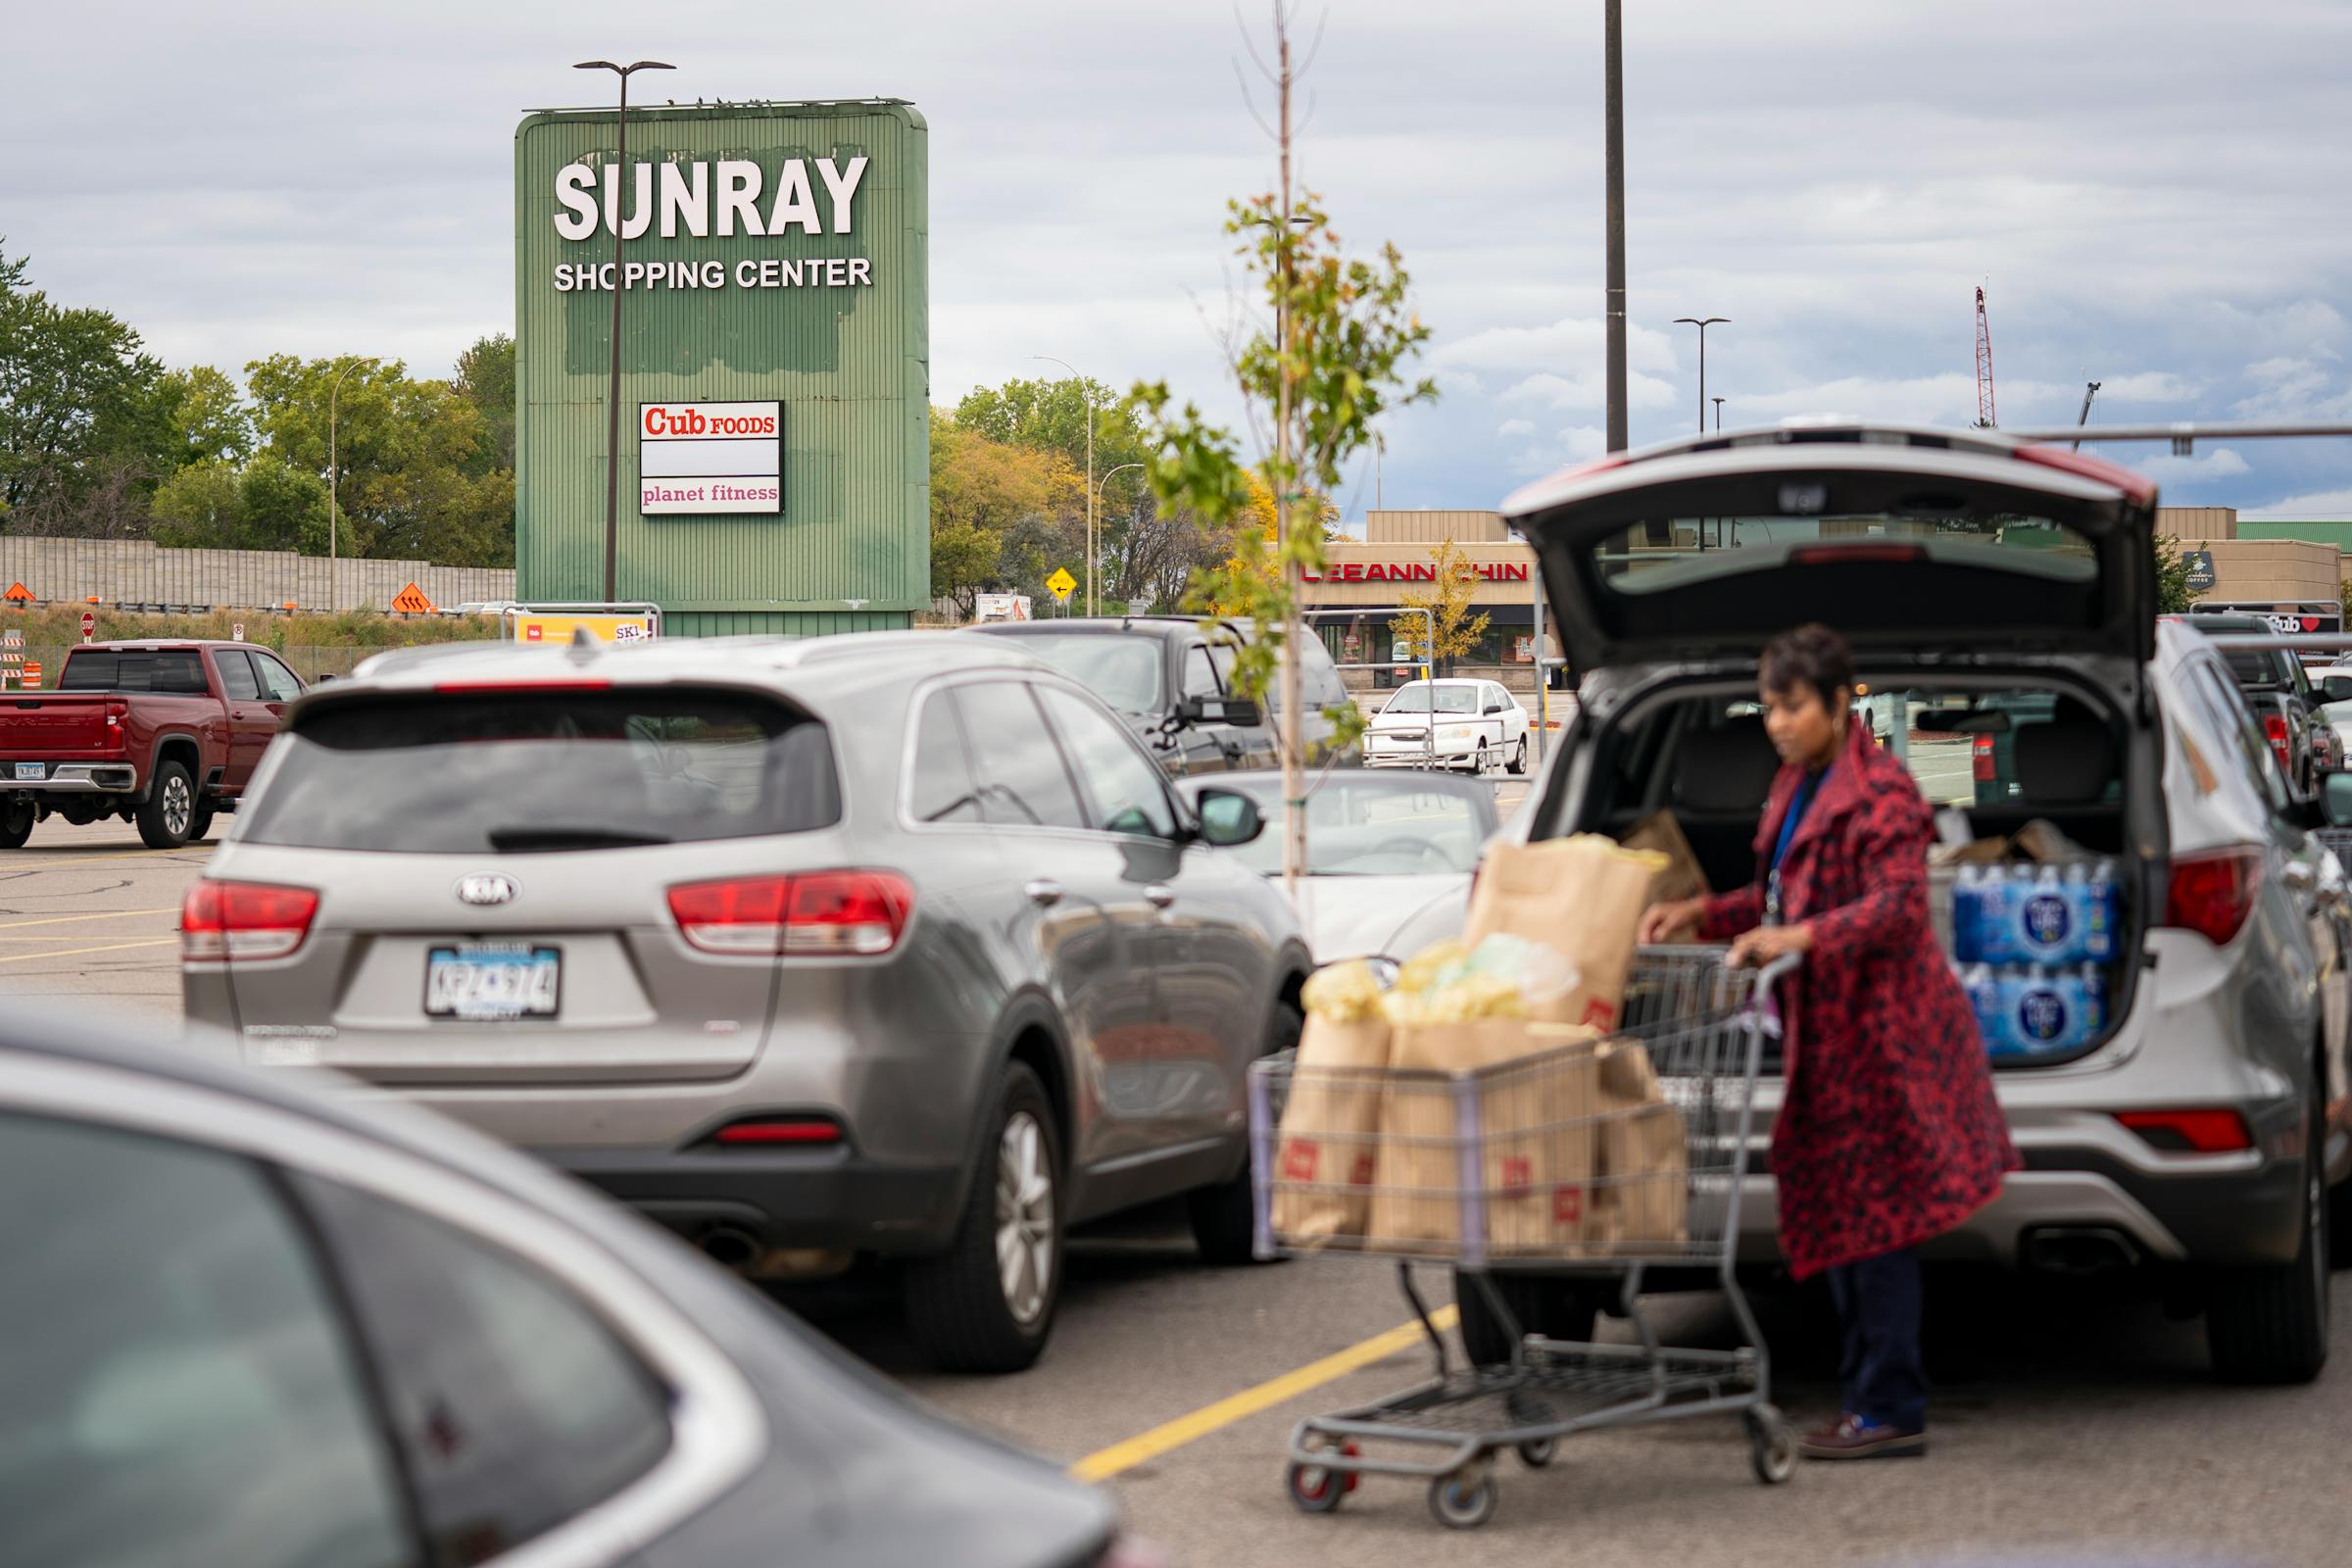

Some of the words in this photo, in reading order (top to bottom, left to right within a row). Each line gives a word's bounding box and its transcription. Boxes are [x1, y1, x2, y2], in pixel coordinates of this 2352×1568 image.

[554, 157, 869, 240] SUNRAY
[554, 261, 725, 291] SHOPPING
[735, 258, 873, 288] CENTER
[645, 408, 706, 435] Cub
[710, 417, 774, 434] FOODS
[643, 486, 705, 506] planet
[711, 485, 778, 501] fitness
[1300, 564, 1436, 581] LEEANN
[82, 620, 94, 630] STOP
[616, 625, 639, 639] SKI
